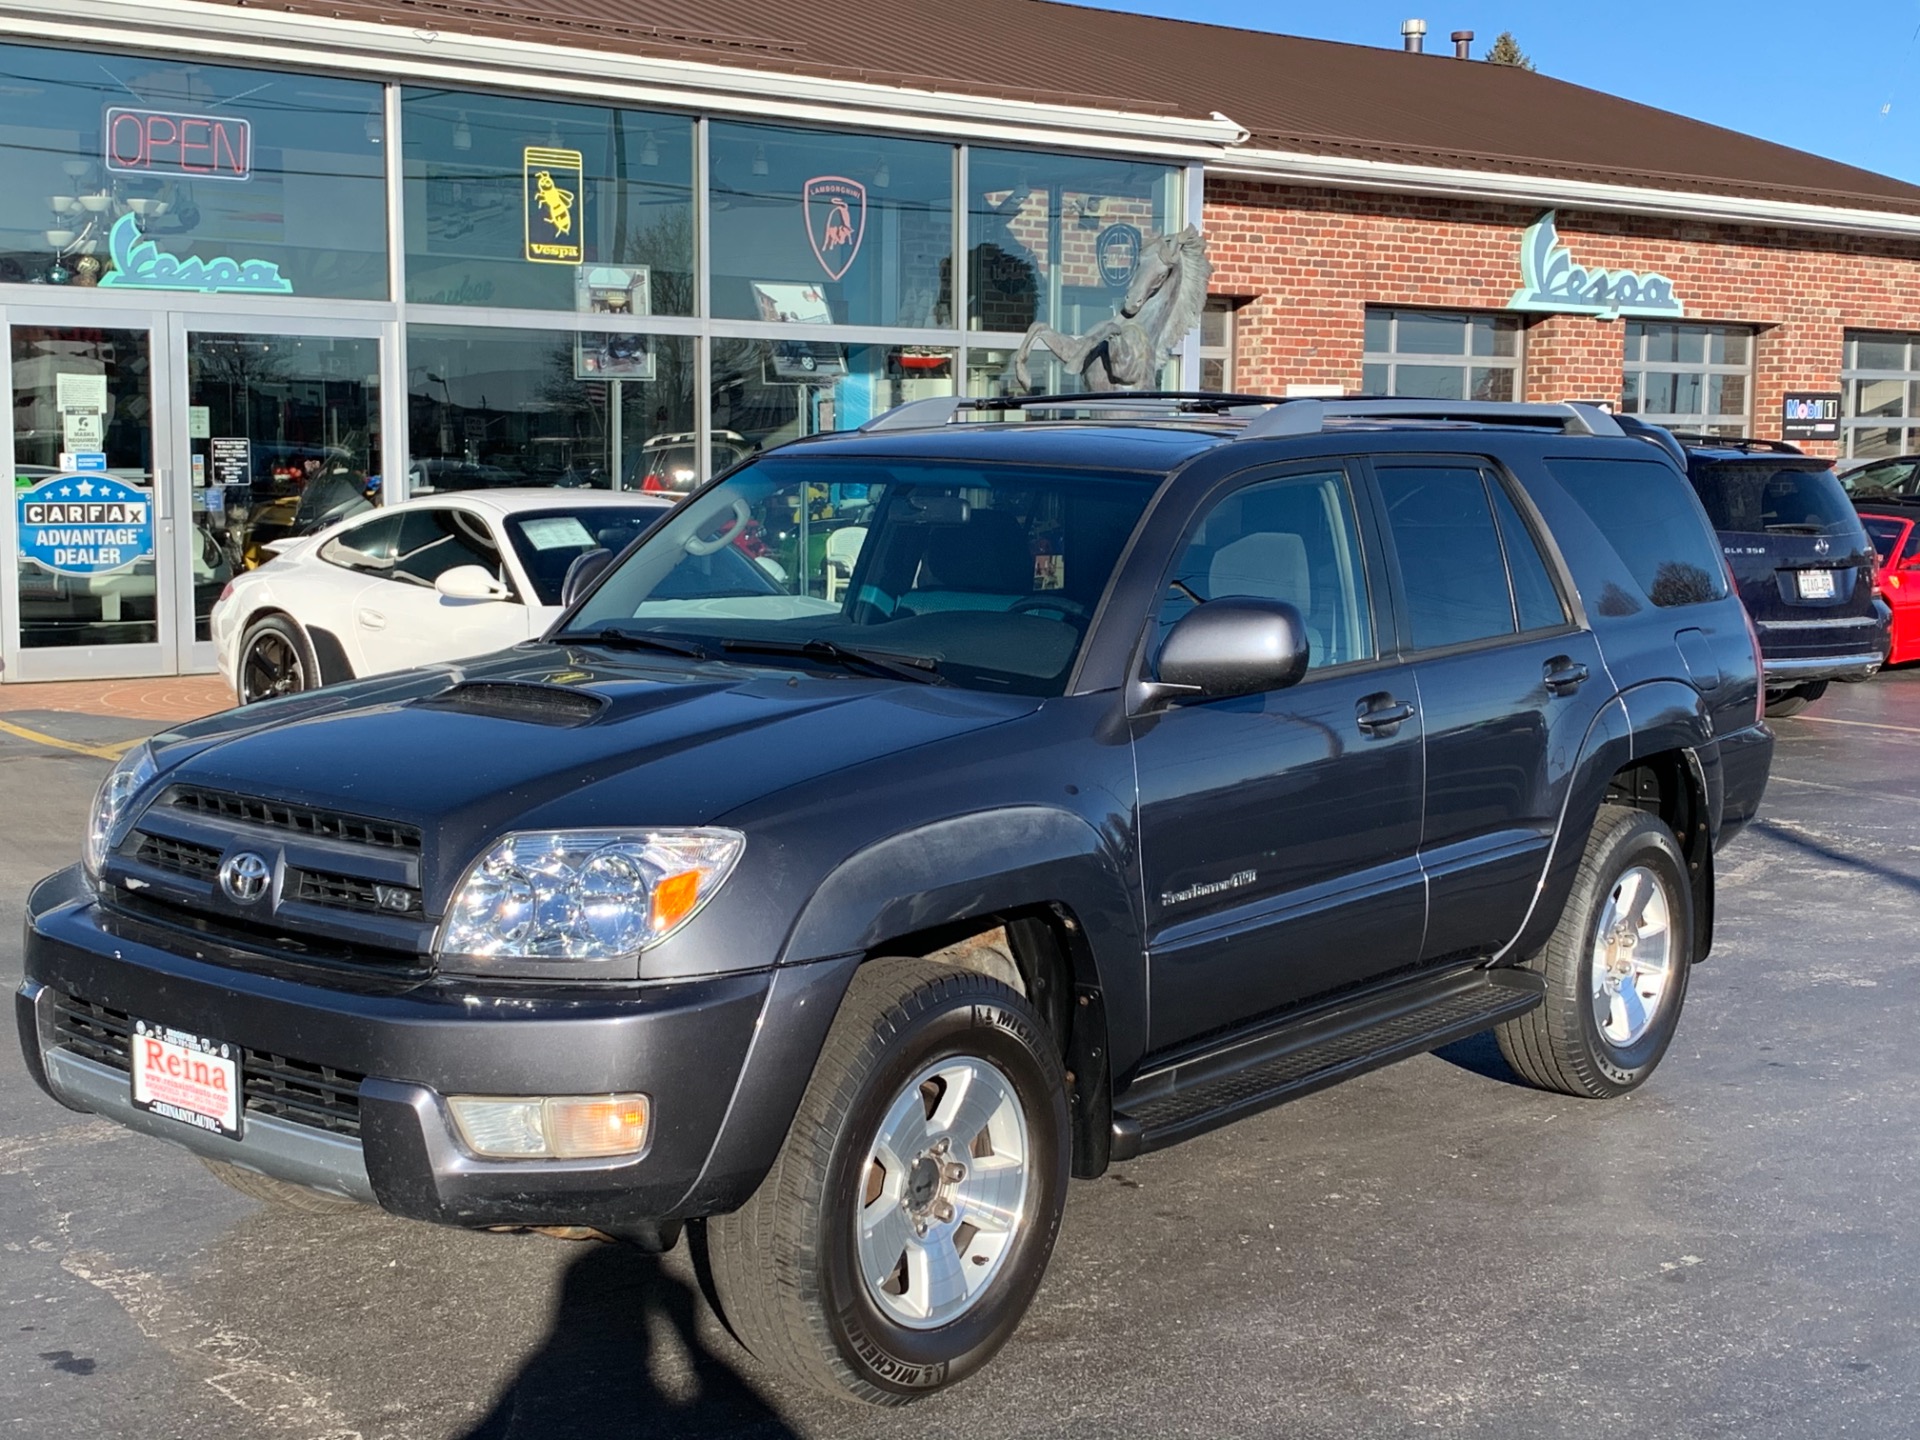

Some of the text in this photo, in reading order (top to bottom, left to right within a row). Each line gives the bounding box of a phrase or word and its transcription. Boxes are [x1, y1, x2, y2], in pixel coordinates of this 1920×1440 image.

[112, 114, 244, 174] OPEN
[810, 185, 861, 199] LAMBORGHINI
[105, 213, 290, 292] Vespa
[531, 244, 579, 258] Vespa
[1518, 211, 1682, 317] Vespa
[1786, 399, 1838, 420] Mobil 1
[27, 504, 143, 524] CARFAX
[36, 529, 138, 546] ADVANTAGE
[54, 548, 121, 565] DEALER
[144, 1038, 228, 1092] Reina
[843, 1317, 921, 1385] MICHELIN
